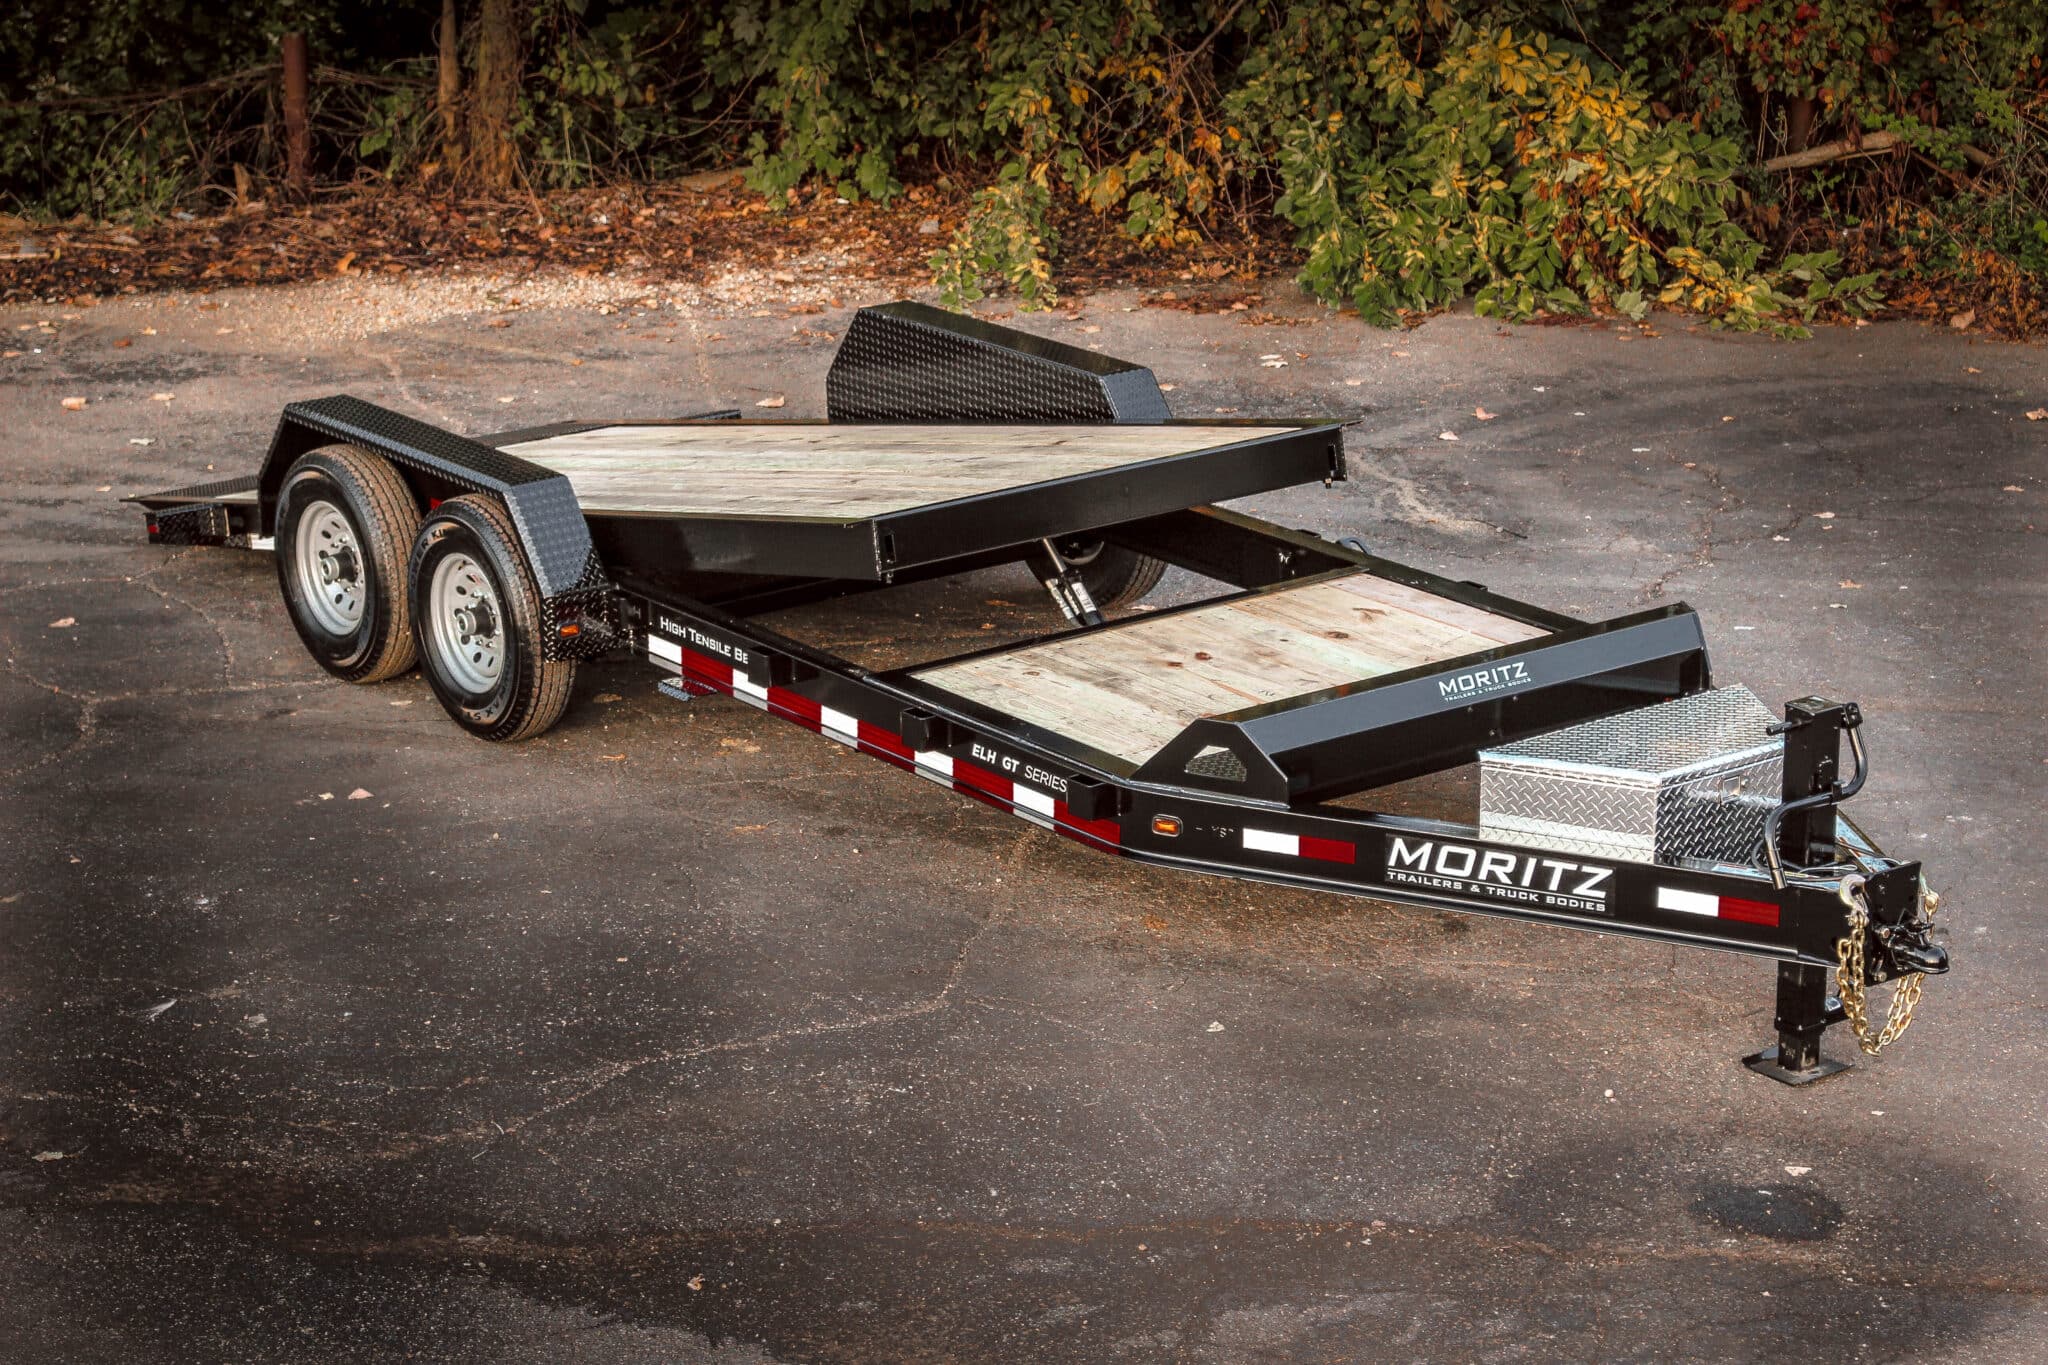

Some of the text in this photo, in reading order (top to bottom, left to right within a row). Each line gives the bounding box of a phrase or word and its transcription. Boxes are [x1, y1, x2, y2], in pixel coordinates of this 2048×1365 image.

[660, 616, 686, 638] HIGH
[688, 628, 732, 657] TENSILE
[1438, 661, 1529, 697] MORITZ
[971, 743, 1068, 793] ELH GT SERIES
[1387, 837, 1615, 899] MORITZ
[1387, 872, 1606, 912] TRAILERS & TRUCK BODIES
